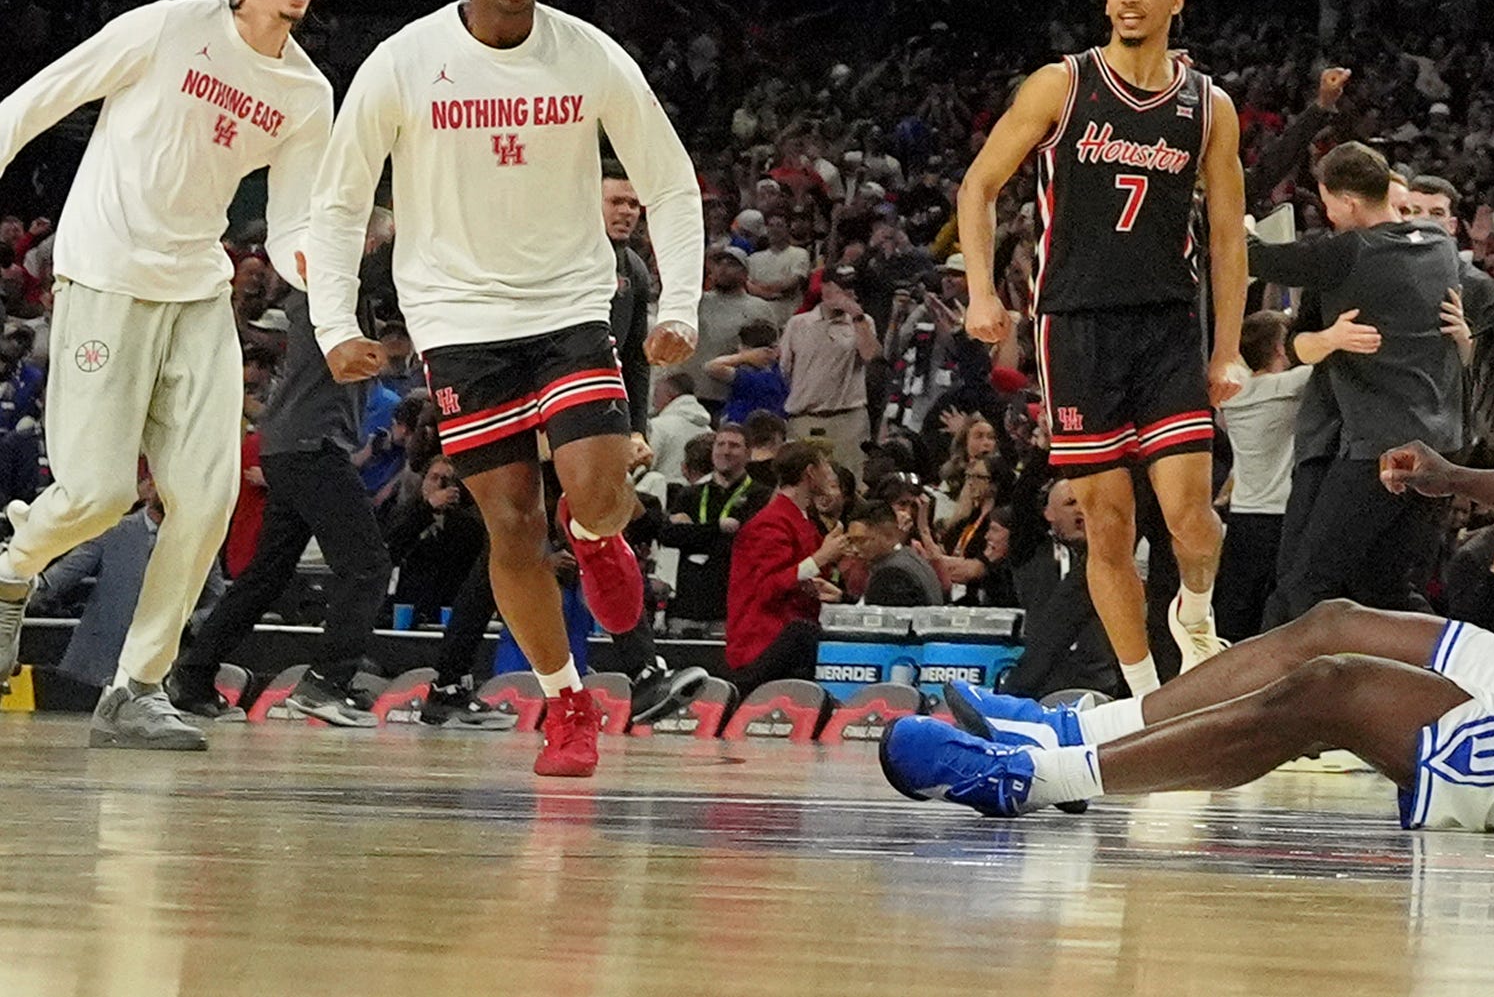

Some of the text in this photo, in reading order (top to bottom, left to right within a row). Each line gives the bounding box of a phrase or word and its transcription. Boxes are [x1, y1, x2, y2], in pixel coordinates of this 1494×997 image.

[181, 69, 253, 119] NOTHING
[431, 95, 584, 130] NOTHING EASY.
[1076, 121, 1190, 174] Houston
[1115, 174, 1148, 231] 7
